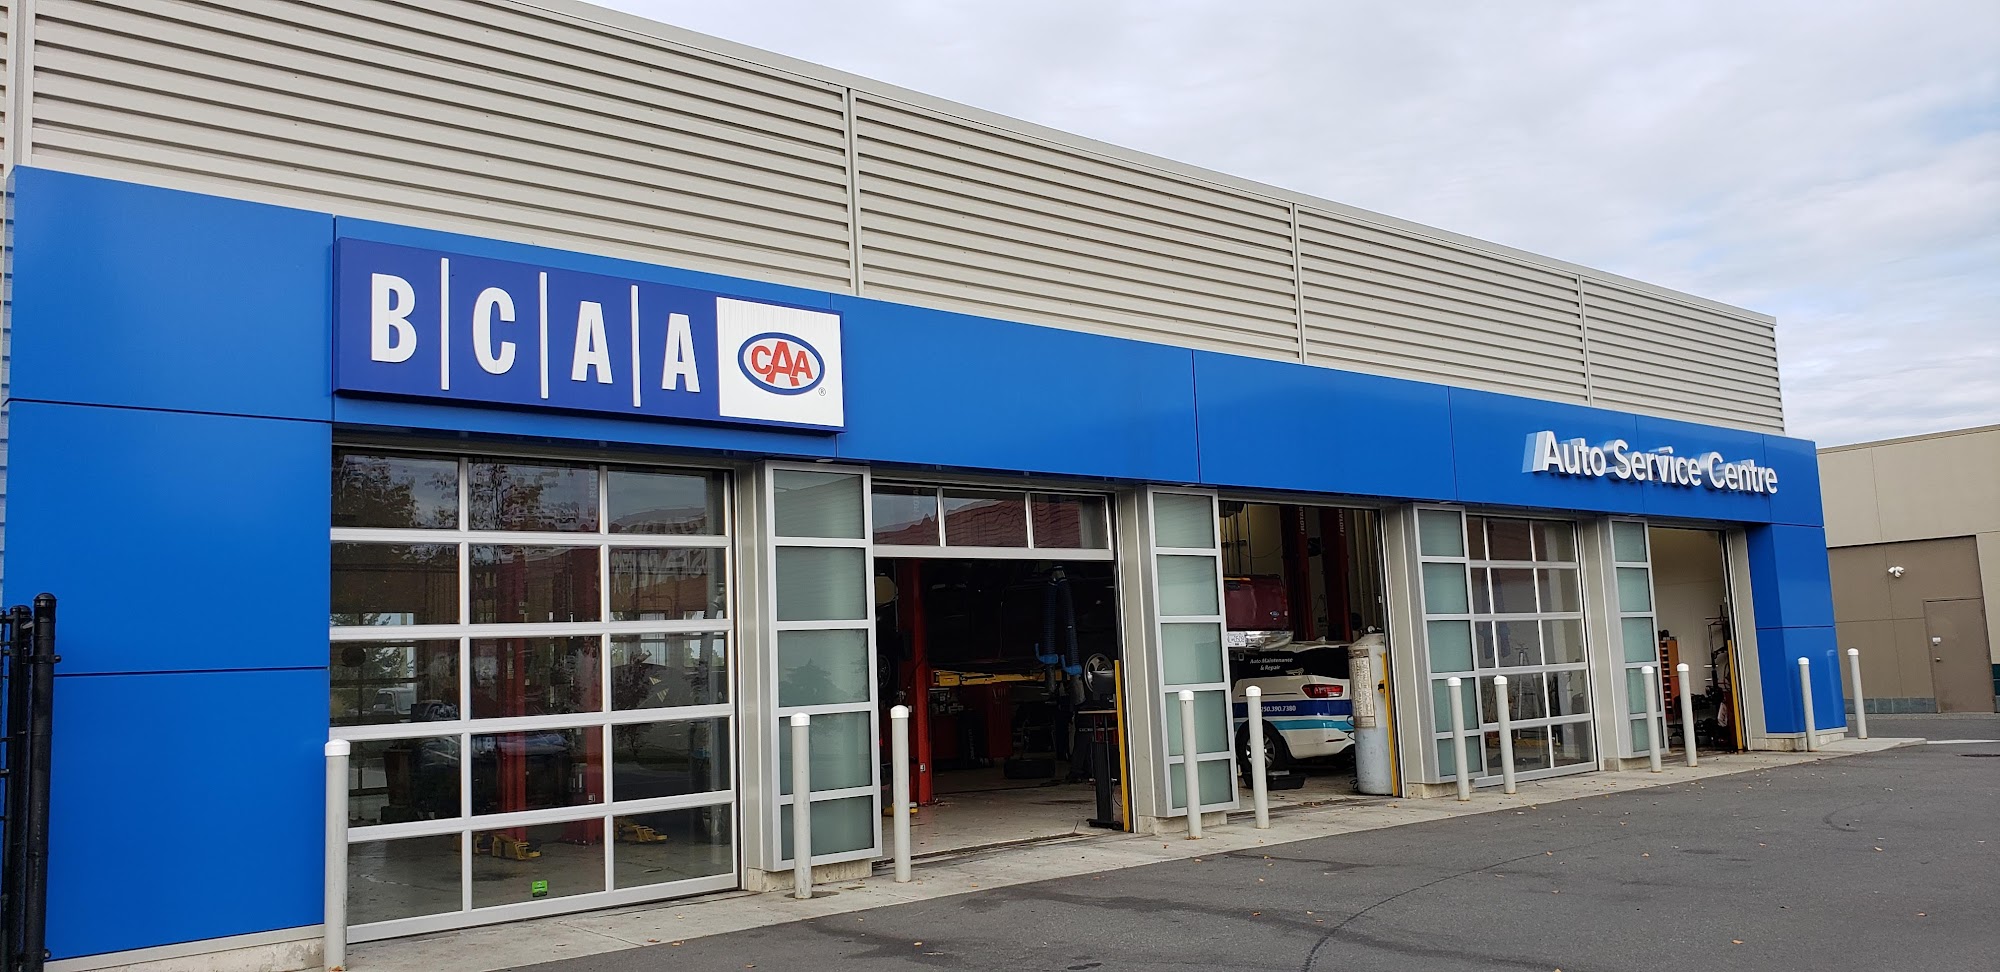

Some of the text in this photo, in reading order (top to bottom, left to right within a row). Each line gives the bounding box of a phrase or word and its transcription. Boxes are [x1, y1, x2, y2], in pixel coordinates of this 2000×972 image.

[751, 340, 814, 387] CAA
[1537, 430, 1778, 494] Auto Service Centre
